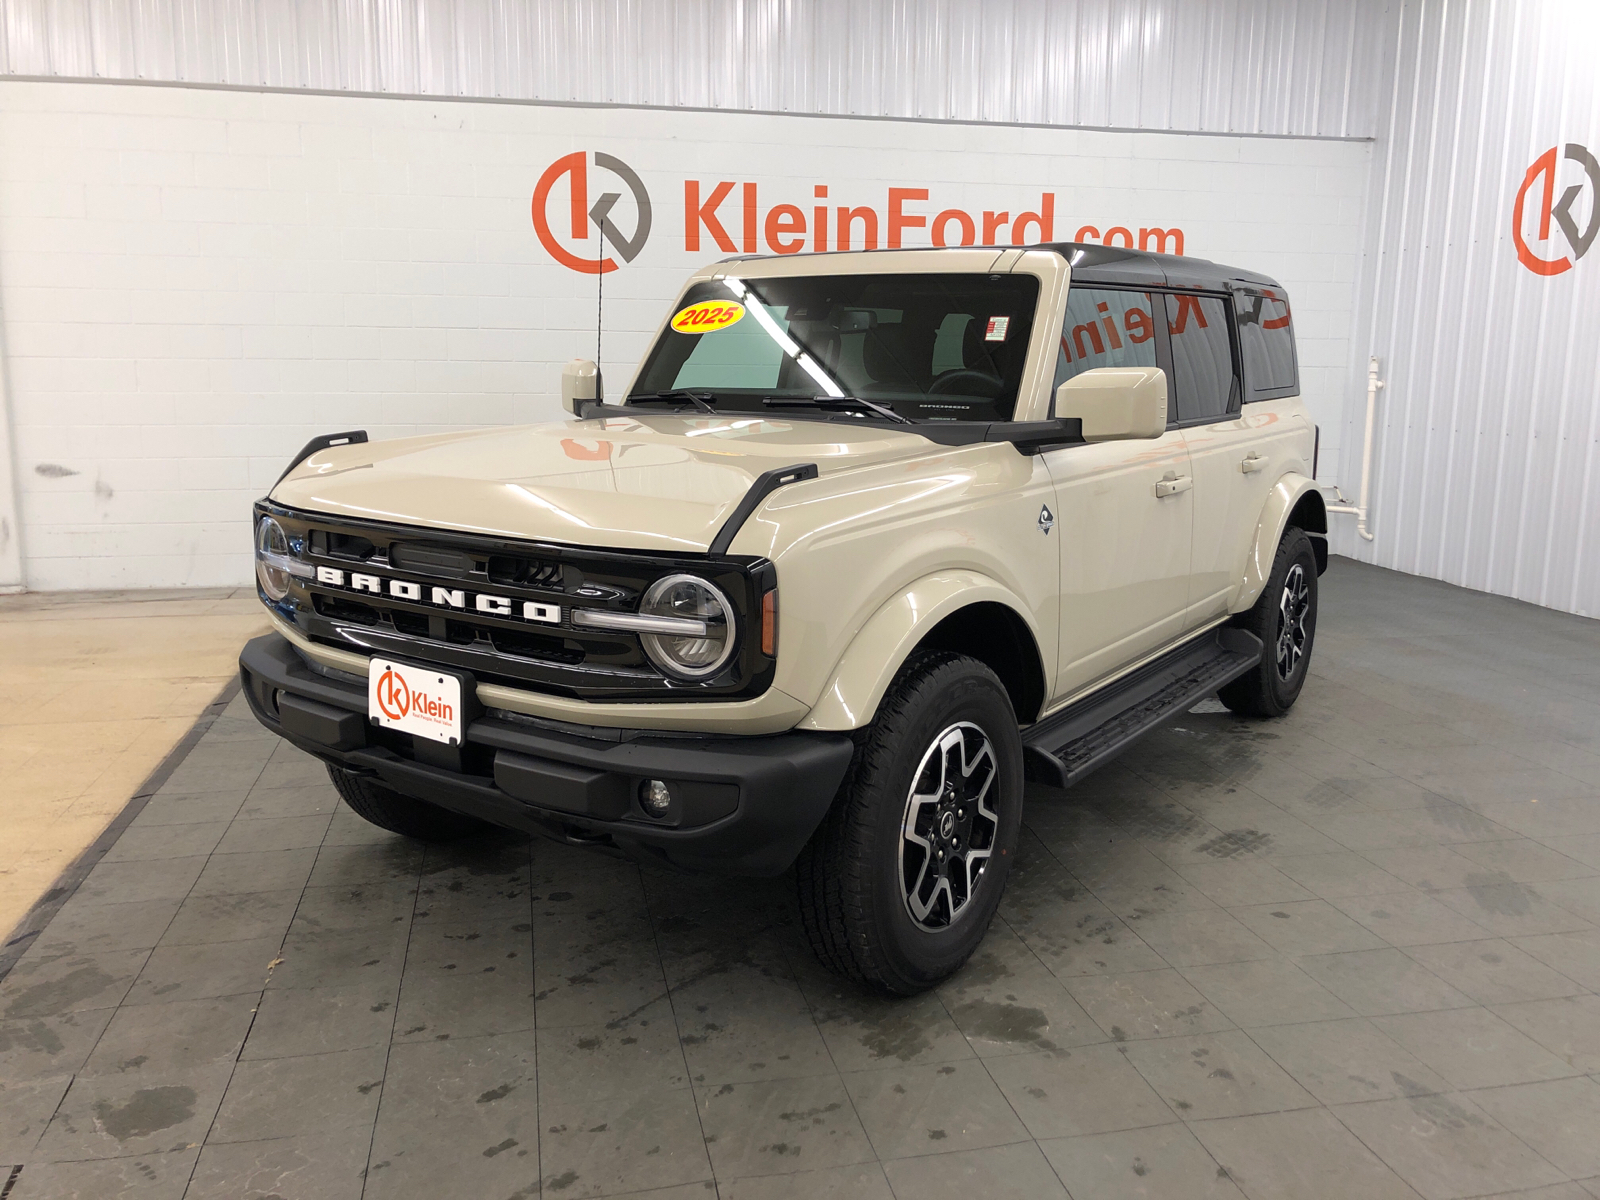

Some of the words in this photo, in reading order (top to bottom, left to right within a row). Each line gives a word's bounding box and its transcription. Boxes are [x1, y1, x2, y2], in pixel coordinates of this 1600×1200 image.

[676, 306, 739, 327] 2025
[317, 566, 561, 623] BRONCO
[412, 690, 453, 721] Klein
